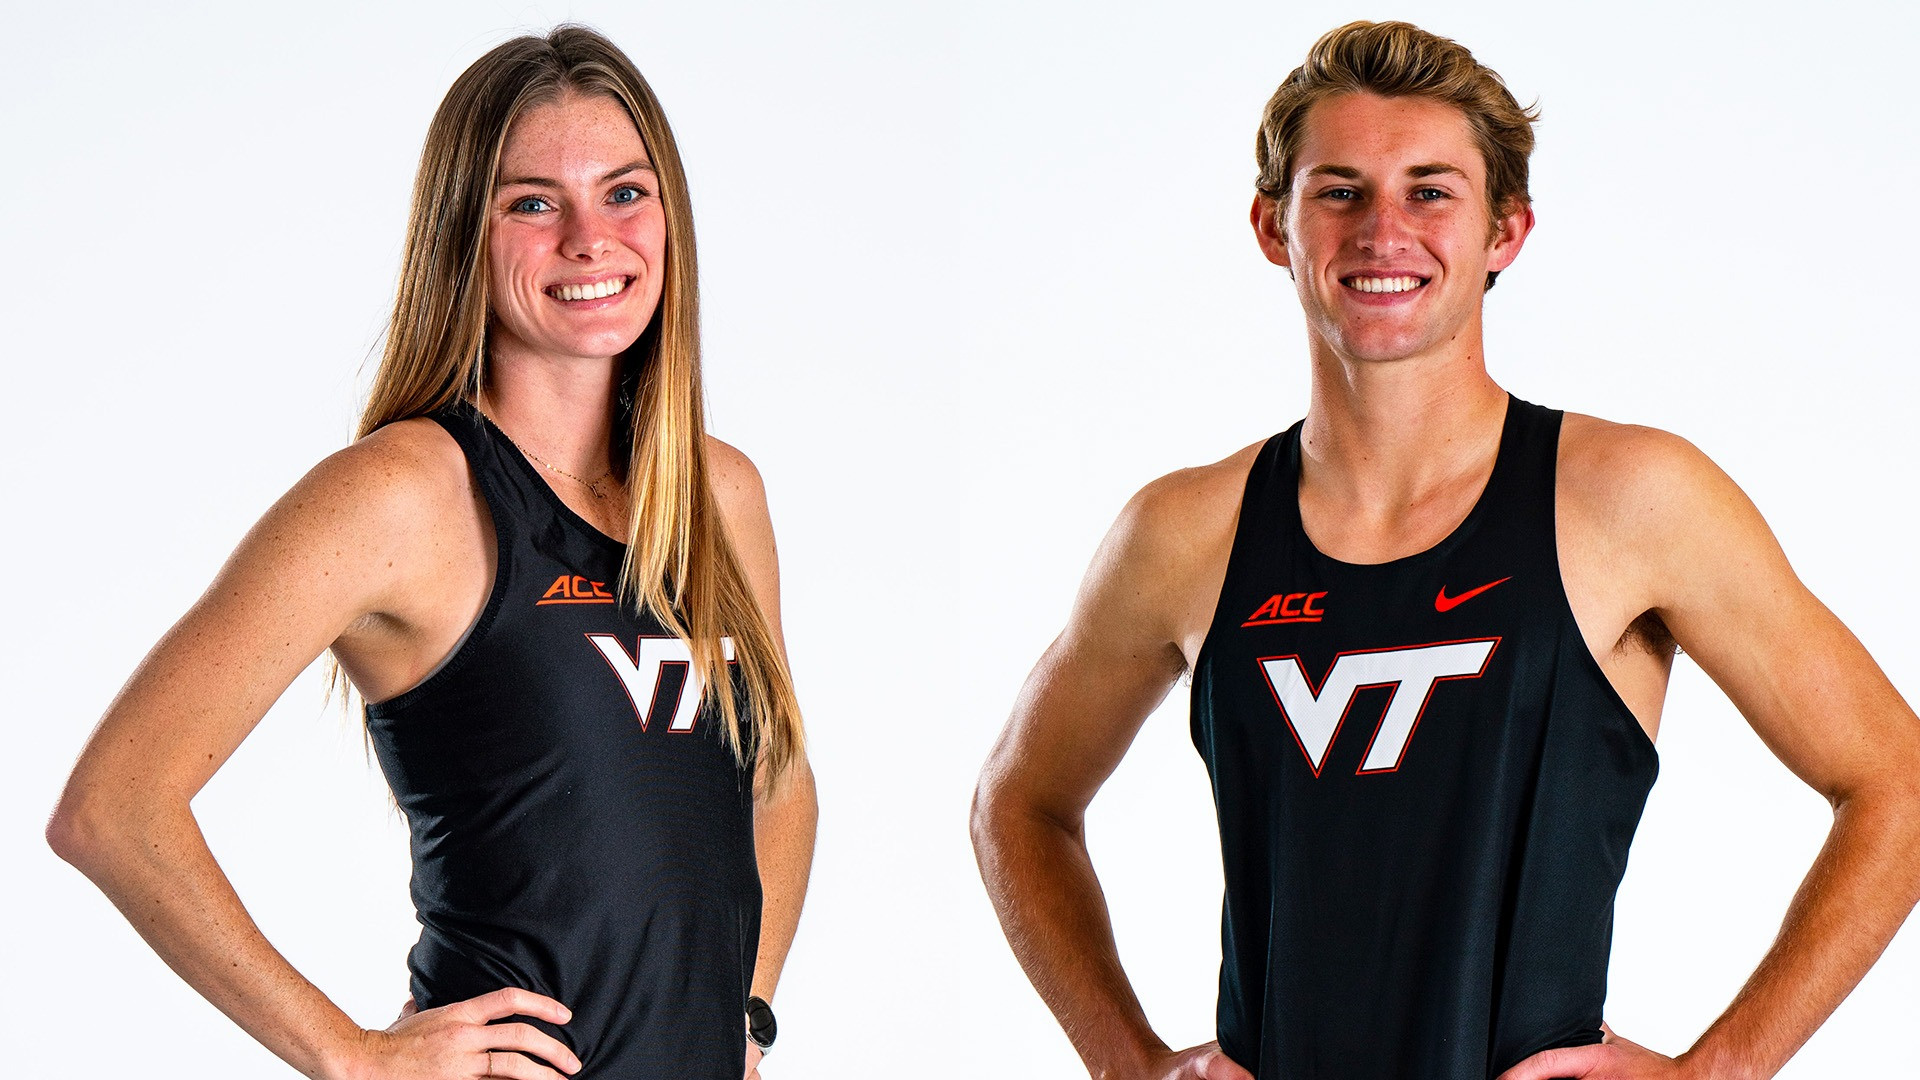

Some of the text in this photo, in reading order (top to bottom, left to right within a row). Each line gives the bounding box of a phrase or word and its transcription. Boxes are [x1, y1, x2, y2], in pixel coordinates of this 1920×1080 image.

[542, 574, 612, 599] ACC
[1248, 591, 1328, 620] ACC
[584, 632, 738, 734] VT
[1256, 636, 1503, 779] VT
